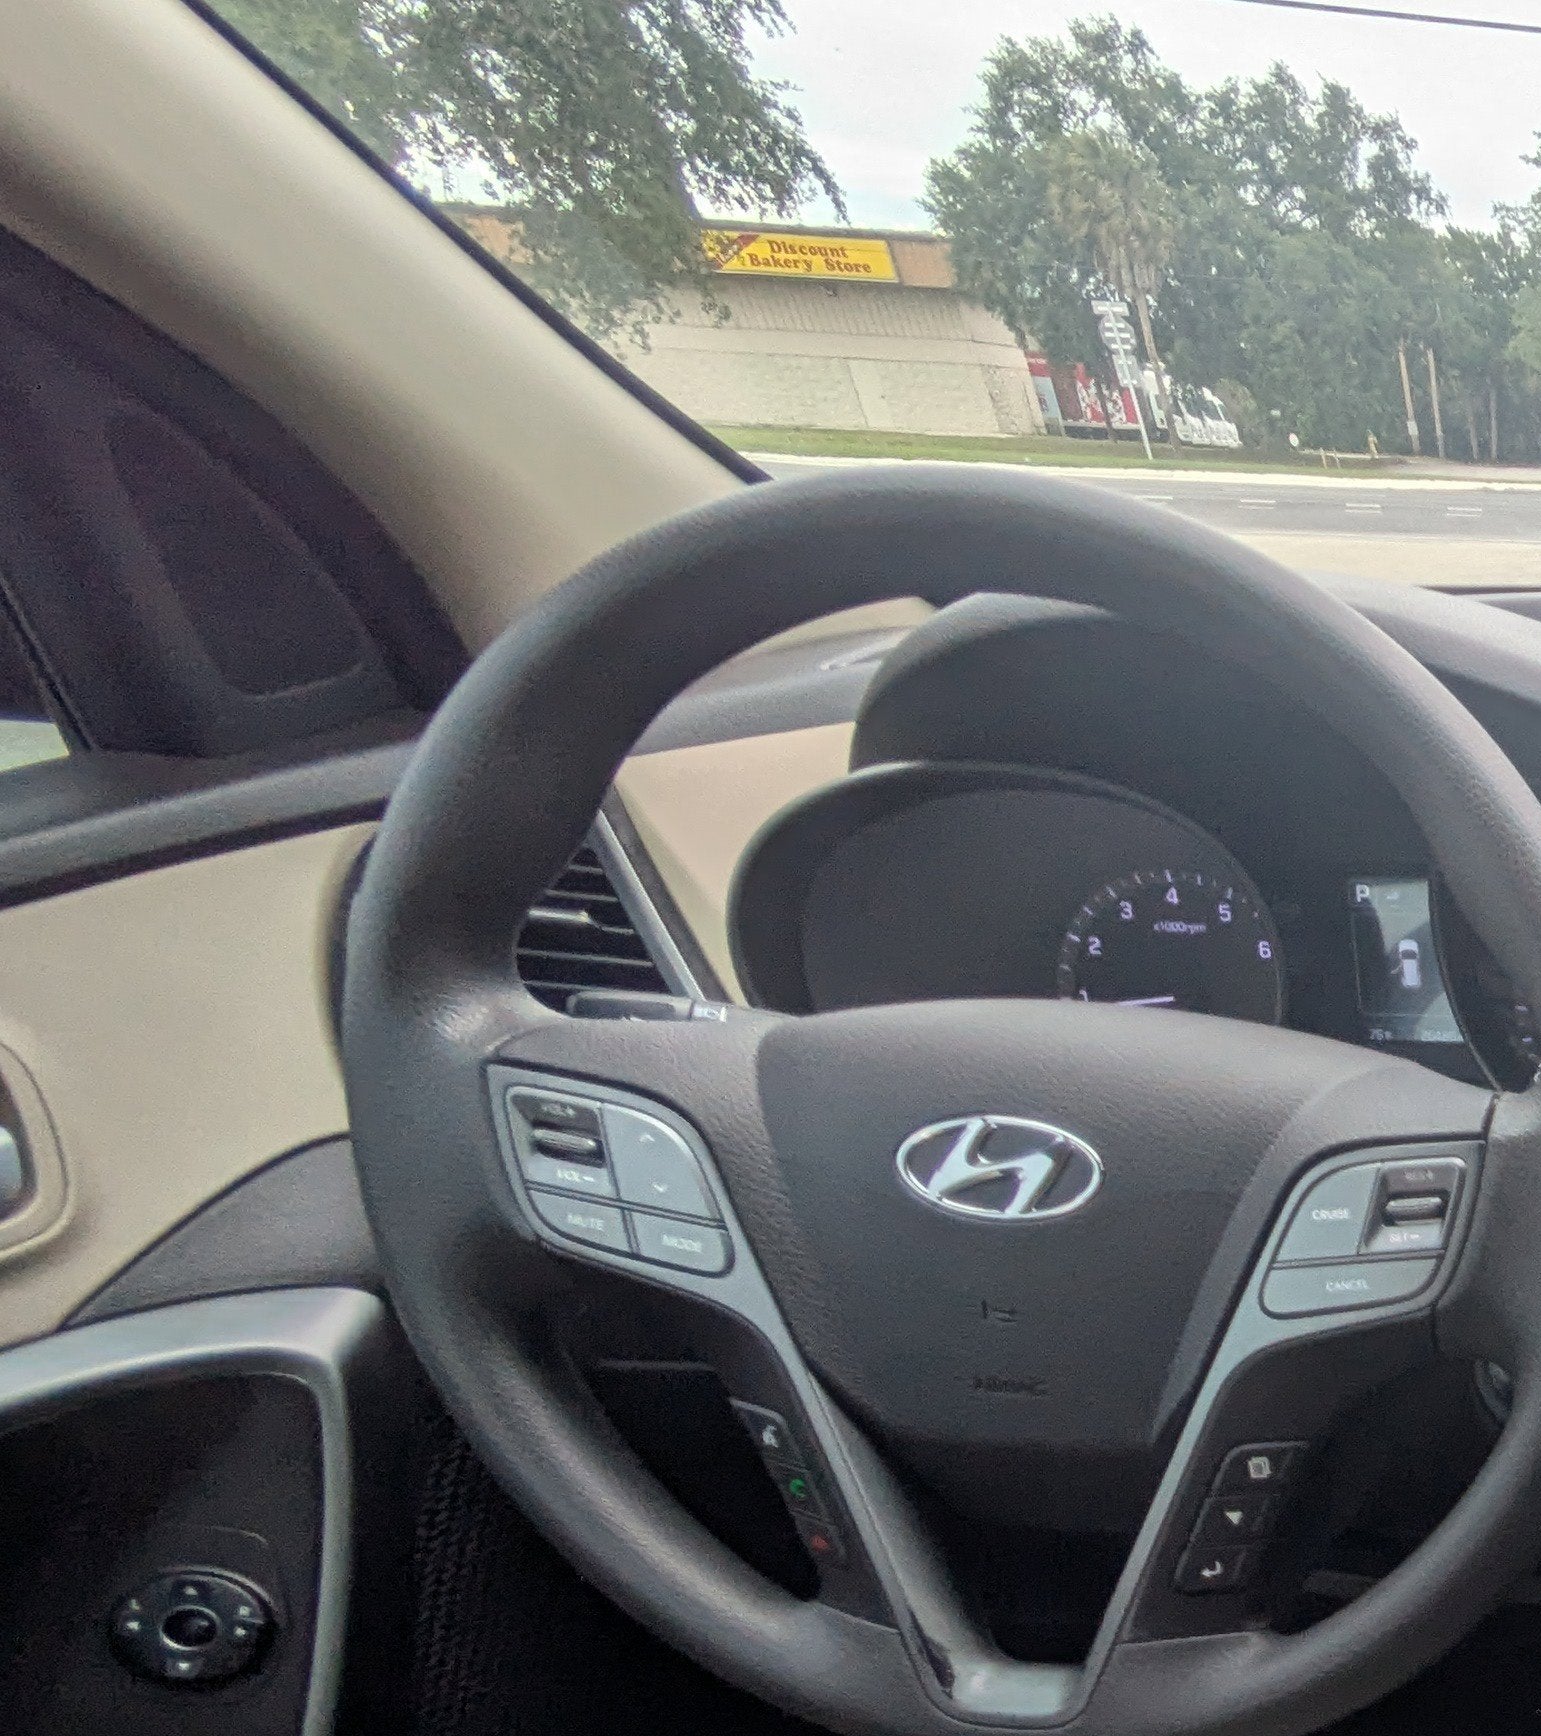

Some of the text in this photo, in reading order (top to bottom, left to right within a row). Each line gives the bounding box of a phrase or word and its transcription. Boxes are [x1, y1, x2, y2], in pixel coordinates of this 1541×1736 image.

[767, 239, 849, 260] Discount
[748, 252, 813, 272] Bakery
[823, 258, 872, 274] Store
[1355, 884, 1370, 903] P
[1119, 900, 1133, 920] 3
[1218, 902, 1232, 923] 5
[1088, 936, 1102, 955] 2
